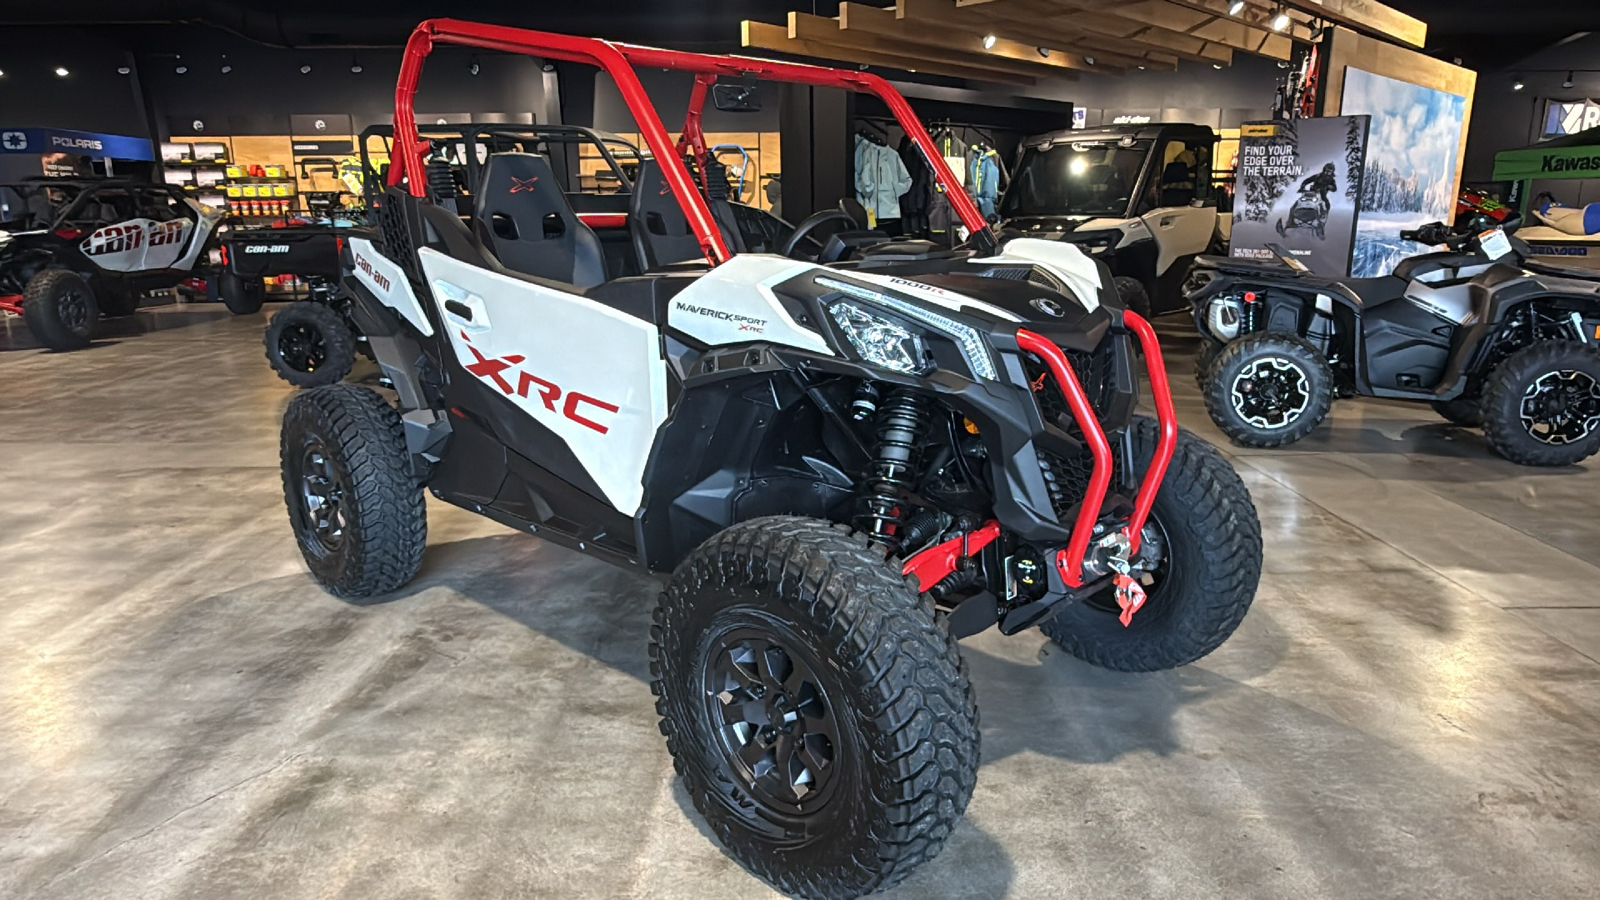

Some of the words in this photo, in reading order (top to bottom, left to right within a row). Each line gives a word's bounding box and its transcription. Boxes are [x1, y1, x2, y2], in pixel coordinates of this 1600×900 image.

[51, 136, 103, 150] POLARIS
[1244, 145, 1266, 156] FIND
[1268, 145, 1293, 156] YOUR
[1243, 156, 1268, 166] EDGE
[1269, 155, 1294, 166] OVER
[1242, 166, 1260, 176] THE
[1262, 165, 1304, 176] TERRAIN.
[245, 245, 290, 254] can-am
[355, 252, 391, 293] can-am
[889, 277, 946, 296] 1000R
[676, 302, 734, 322] MAVERICK
[733, 314, 767, 326] SPORT
[738, 322, 765, 334] XRC
[460, 329, 620, 435] XRC
